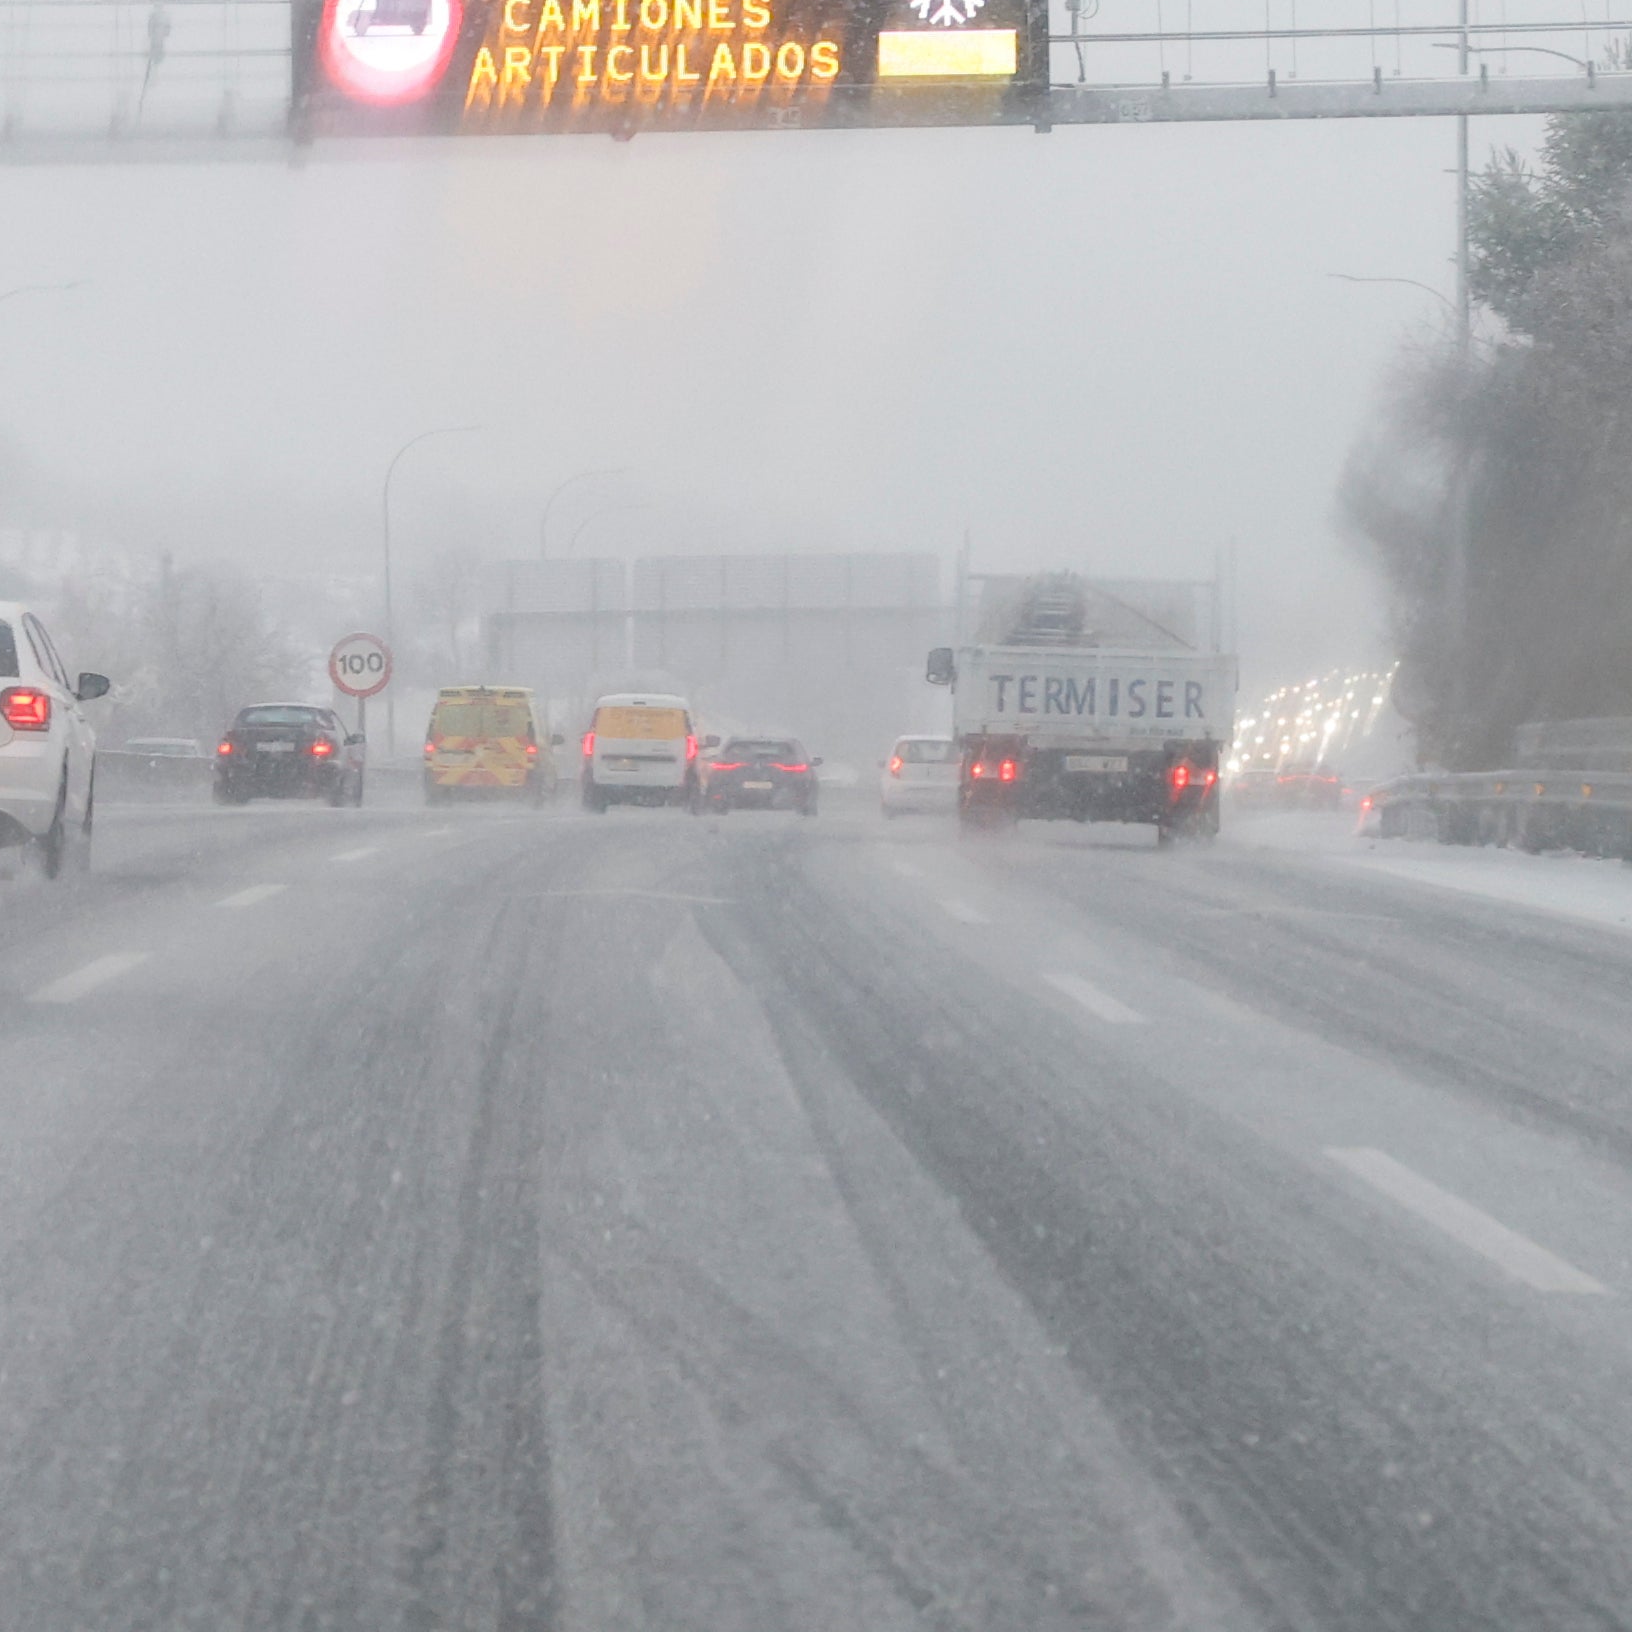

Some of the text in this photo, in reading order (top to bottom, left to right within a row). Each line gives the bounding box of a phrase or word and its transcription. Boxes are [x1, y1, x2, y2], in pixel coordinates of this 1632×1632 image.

[470, 41, 840, 83] ARTICULADOS
[338, 652, 383, 675] 100
[989, 674, 1205, 719] TERMISER
